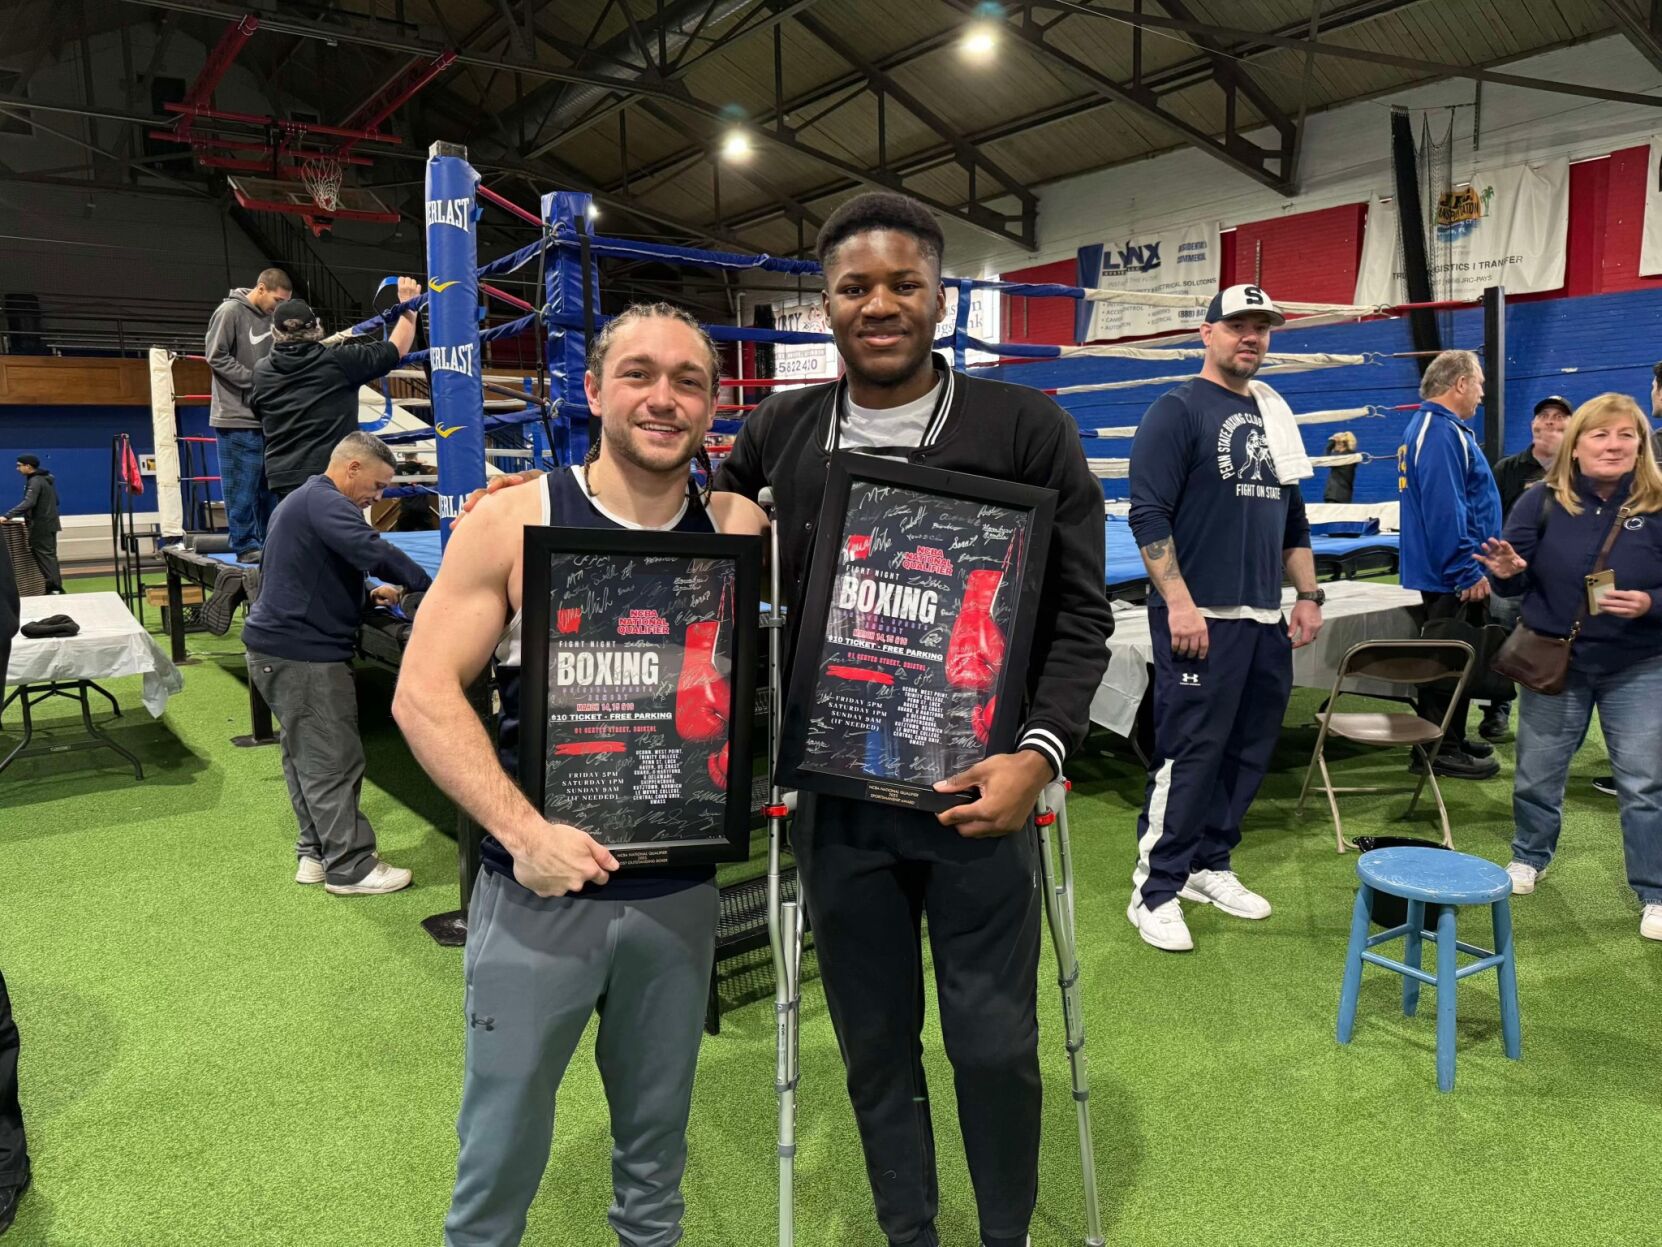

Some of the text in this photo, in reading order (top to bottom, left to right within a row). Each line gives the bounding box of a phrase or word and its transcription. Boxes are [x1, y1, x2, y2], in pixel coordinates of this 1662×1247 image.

[1102, 240, 1161, 273] LYNX
[1244, 286, 1264, 305] S
[1222, 412, 1246, 432] BOXING
[1217, 428, 1233, 453] STATE
[1217, 454, 1235, 480] PENN
[1236, 483, 1280, 500] FIGHT ON STATE
[905, 552, 953, 567] NATIONAL
[846, 565, 900, 580] FIGHT NIGHT
[902, 560, 953, 576] QUALIFIER
[839, 575, 938, 624] BOXING
[629, 609, 658, 618] NCBA
[618, 617, 669, 627] NATIONAL
[617, 626, 670, 635] QUALIFIER
[559, 640, 585, 648] FIGHT
[590, 640, 616, 648] NIGHT
[845, 638, 876, 649] TICKET
[882, 645, 905, 655] FREE
[906, 648, 943, 662] PARKING
[557, 652, 659, 686] BOXING
[835, 695, 864, 706] FRIDAY
[634, 712, 673, 720] PARKING
[828, 702, 887, 717] SATURDAY 1PM
[831, 710, 862, 721] SUNDAY
[845, 721, 880, 732] NEEDED)
[562, 779, 605, 787] SATURDAY
